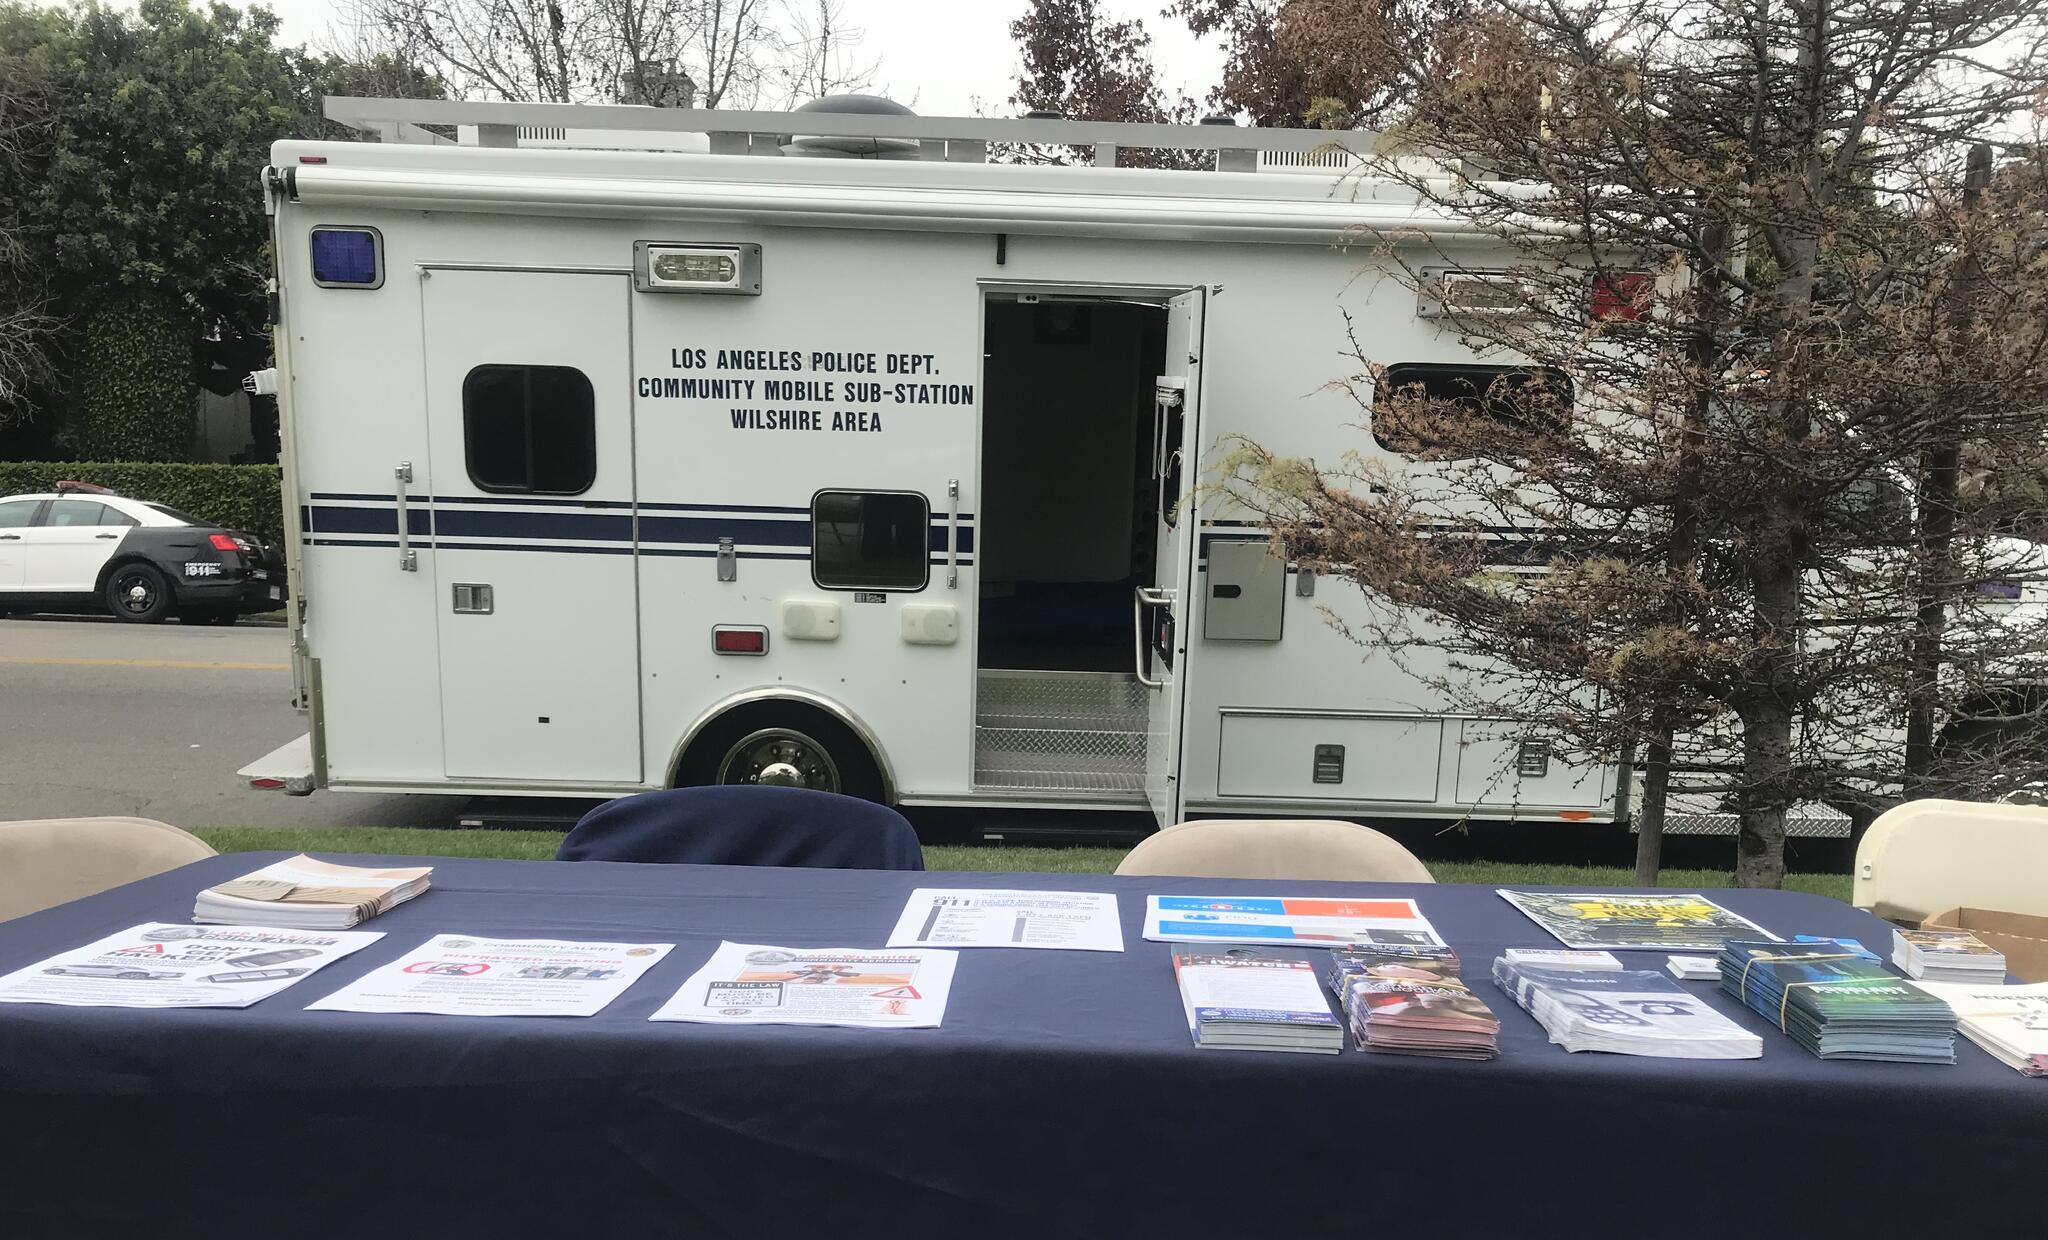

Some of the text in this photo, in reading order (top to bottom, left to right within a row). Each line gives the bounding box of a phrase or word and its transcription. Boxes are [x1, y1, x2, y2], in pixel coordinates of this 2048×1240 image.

[671, 348, 940, 375] LOS ANGELES POLICE DEPT.
[638, 377, 974, 405] COMMUNITY MOBILE SUB-STATION
[730, 409, 882, 432] WILSHIRE AREA
